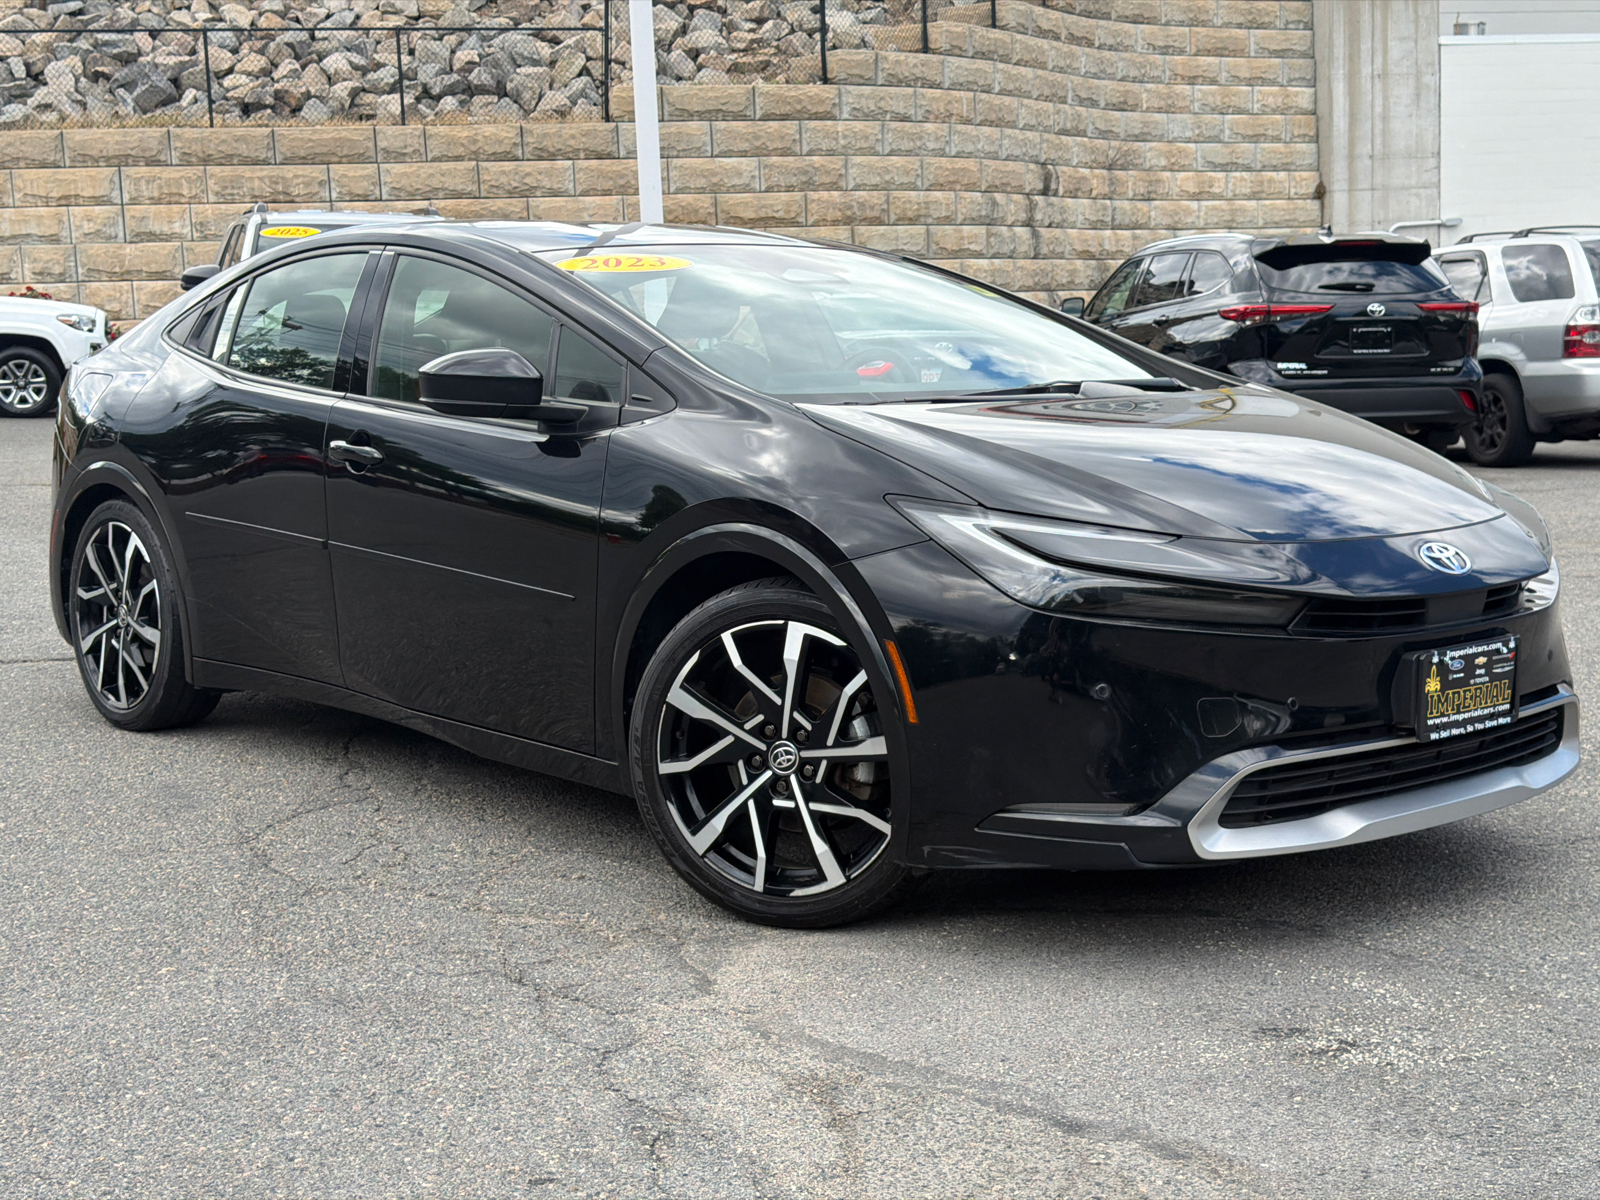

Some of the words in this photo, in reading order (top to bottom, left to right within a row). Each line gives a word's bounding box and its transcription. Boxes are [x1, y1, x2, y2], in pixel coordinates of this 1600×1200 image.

[270, 227, 311, 236] 2025
[580, 256, 666, 270] 2023
[1446, 642, 1503, 658] Imperialcars.com
[1427, 680, 1512, 717] IMPERIAL
[1427, 703, 1510, 725] www.imperialcars.com
[1430, 732, 1440, 740] We
[1440, 728, 1451, 739] Sell
[1451, 726, 1466, 736] More,
[1466, 724, 1475, 733] So
[1474, 722, 1485, 731] You
[1485, 720, 1497, 728] Save
[1498, 716, 1511, 725] More
